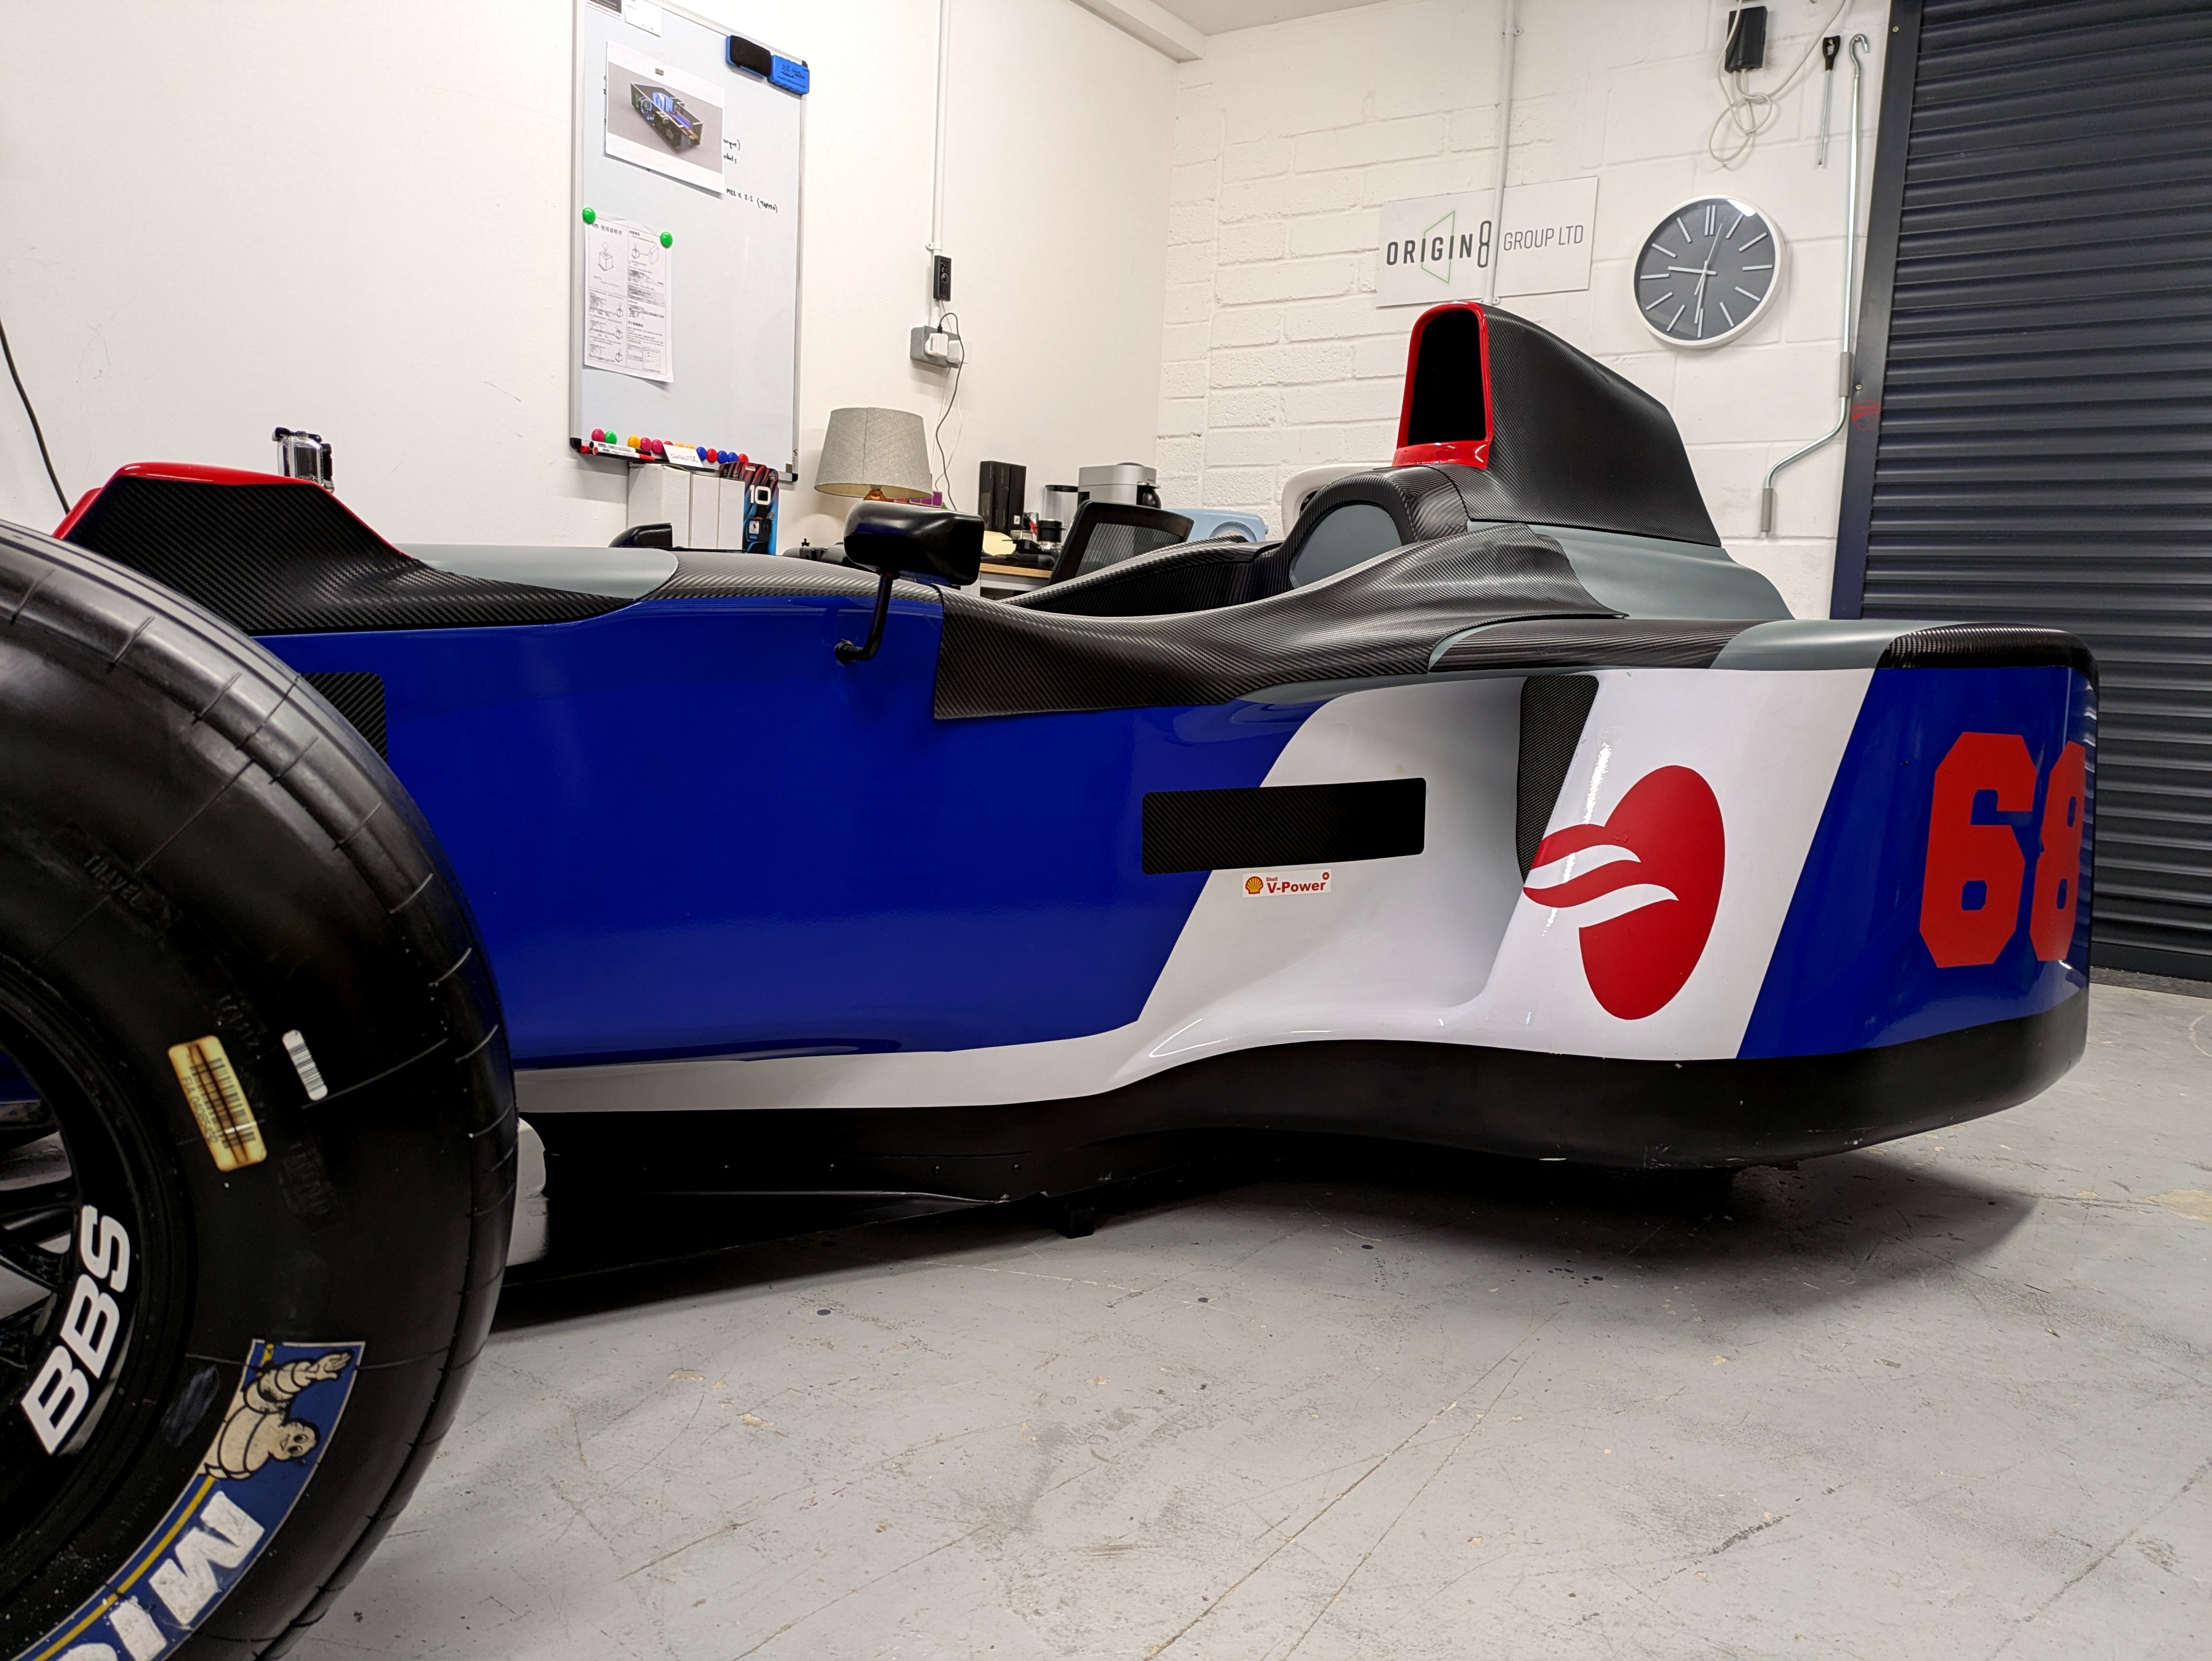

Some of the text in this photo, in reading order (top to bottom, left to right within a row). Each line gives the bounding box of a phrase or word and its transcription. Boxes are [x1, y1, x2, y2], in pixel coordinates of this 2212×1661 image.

[1503, 224, 1584, 251] GROUP LTD
[749, 484, 772, 506] 10
[1919, 731, 2086, 968] 68
[1267, 881, 1327, 894] V-Power
[21, 1205, 131, 1455] BBS
